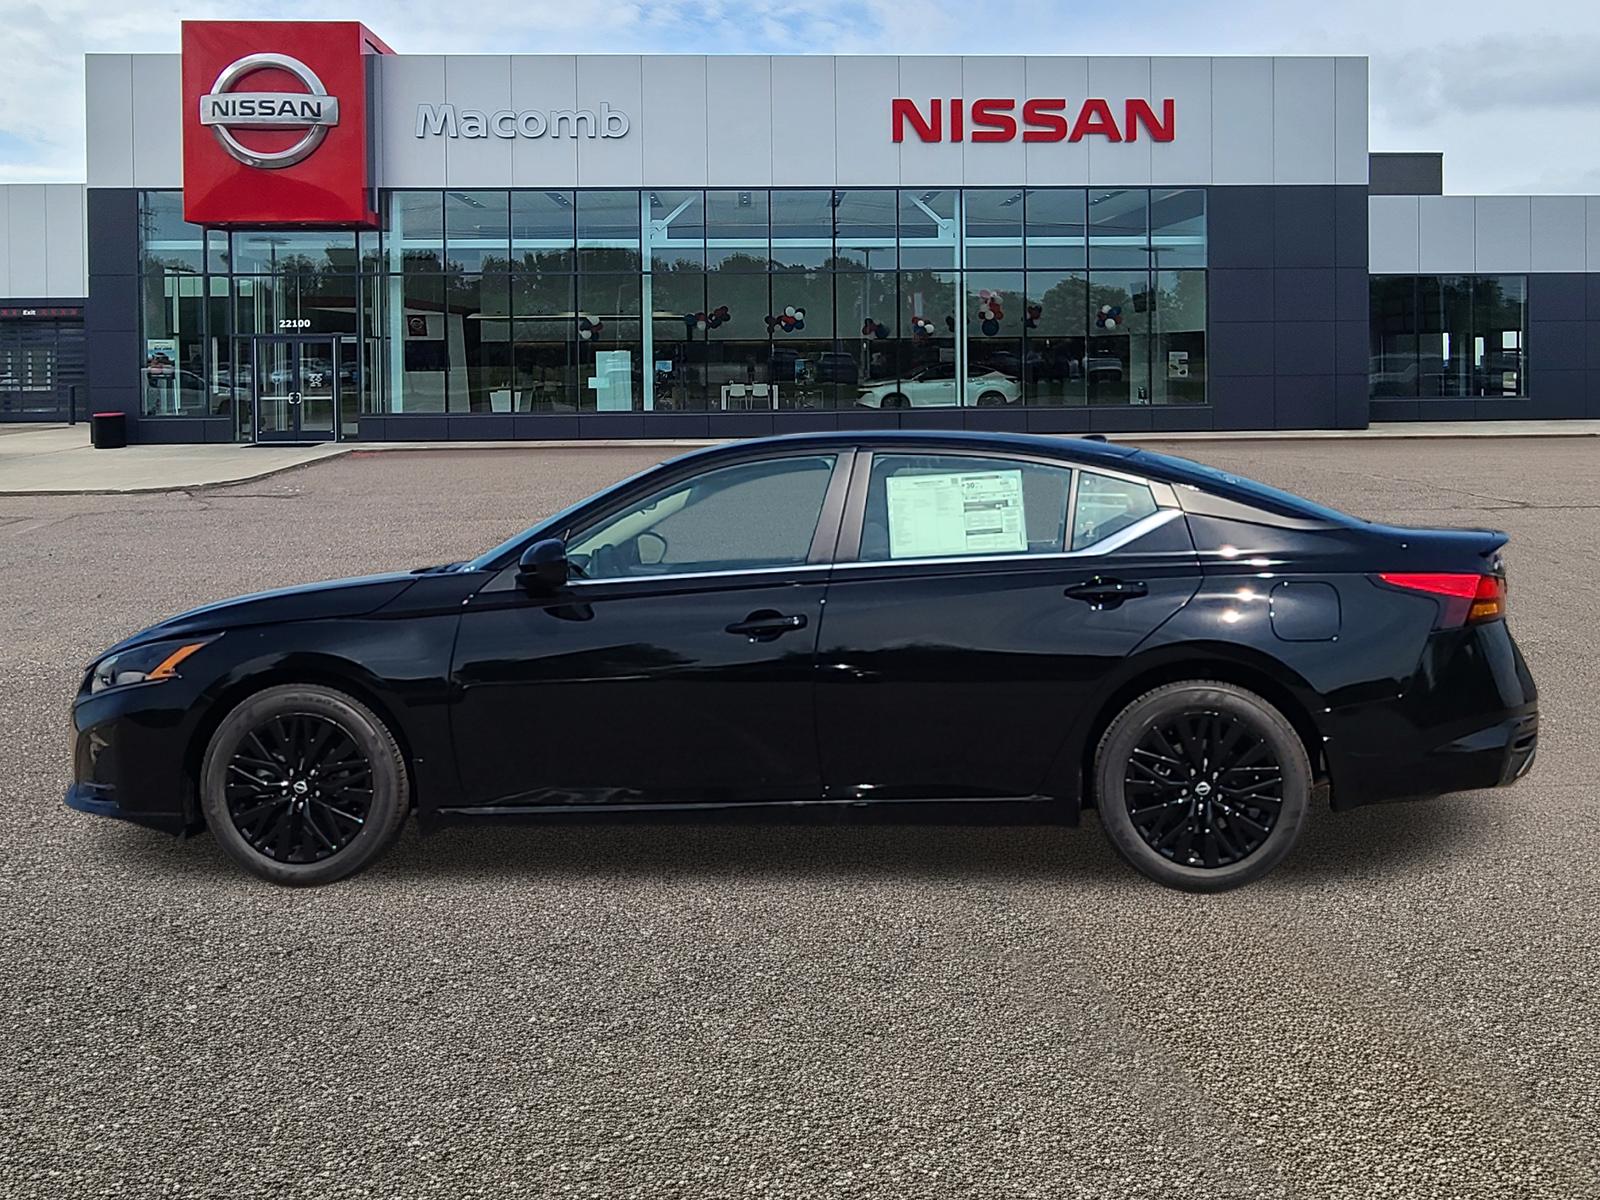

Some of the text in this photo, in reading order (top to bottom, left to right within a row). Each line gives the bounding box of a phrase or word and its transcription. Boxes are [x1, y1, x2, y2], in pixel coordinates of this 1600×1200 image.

[211, 100, 322, 117] NISSAN
[415, 102, 630, 138] Macomb
[892, 98, 1175, 142] NISSAN
[279, 319, 311, 328] 22100
